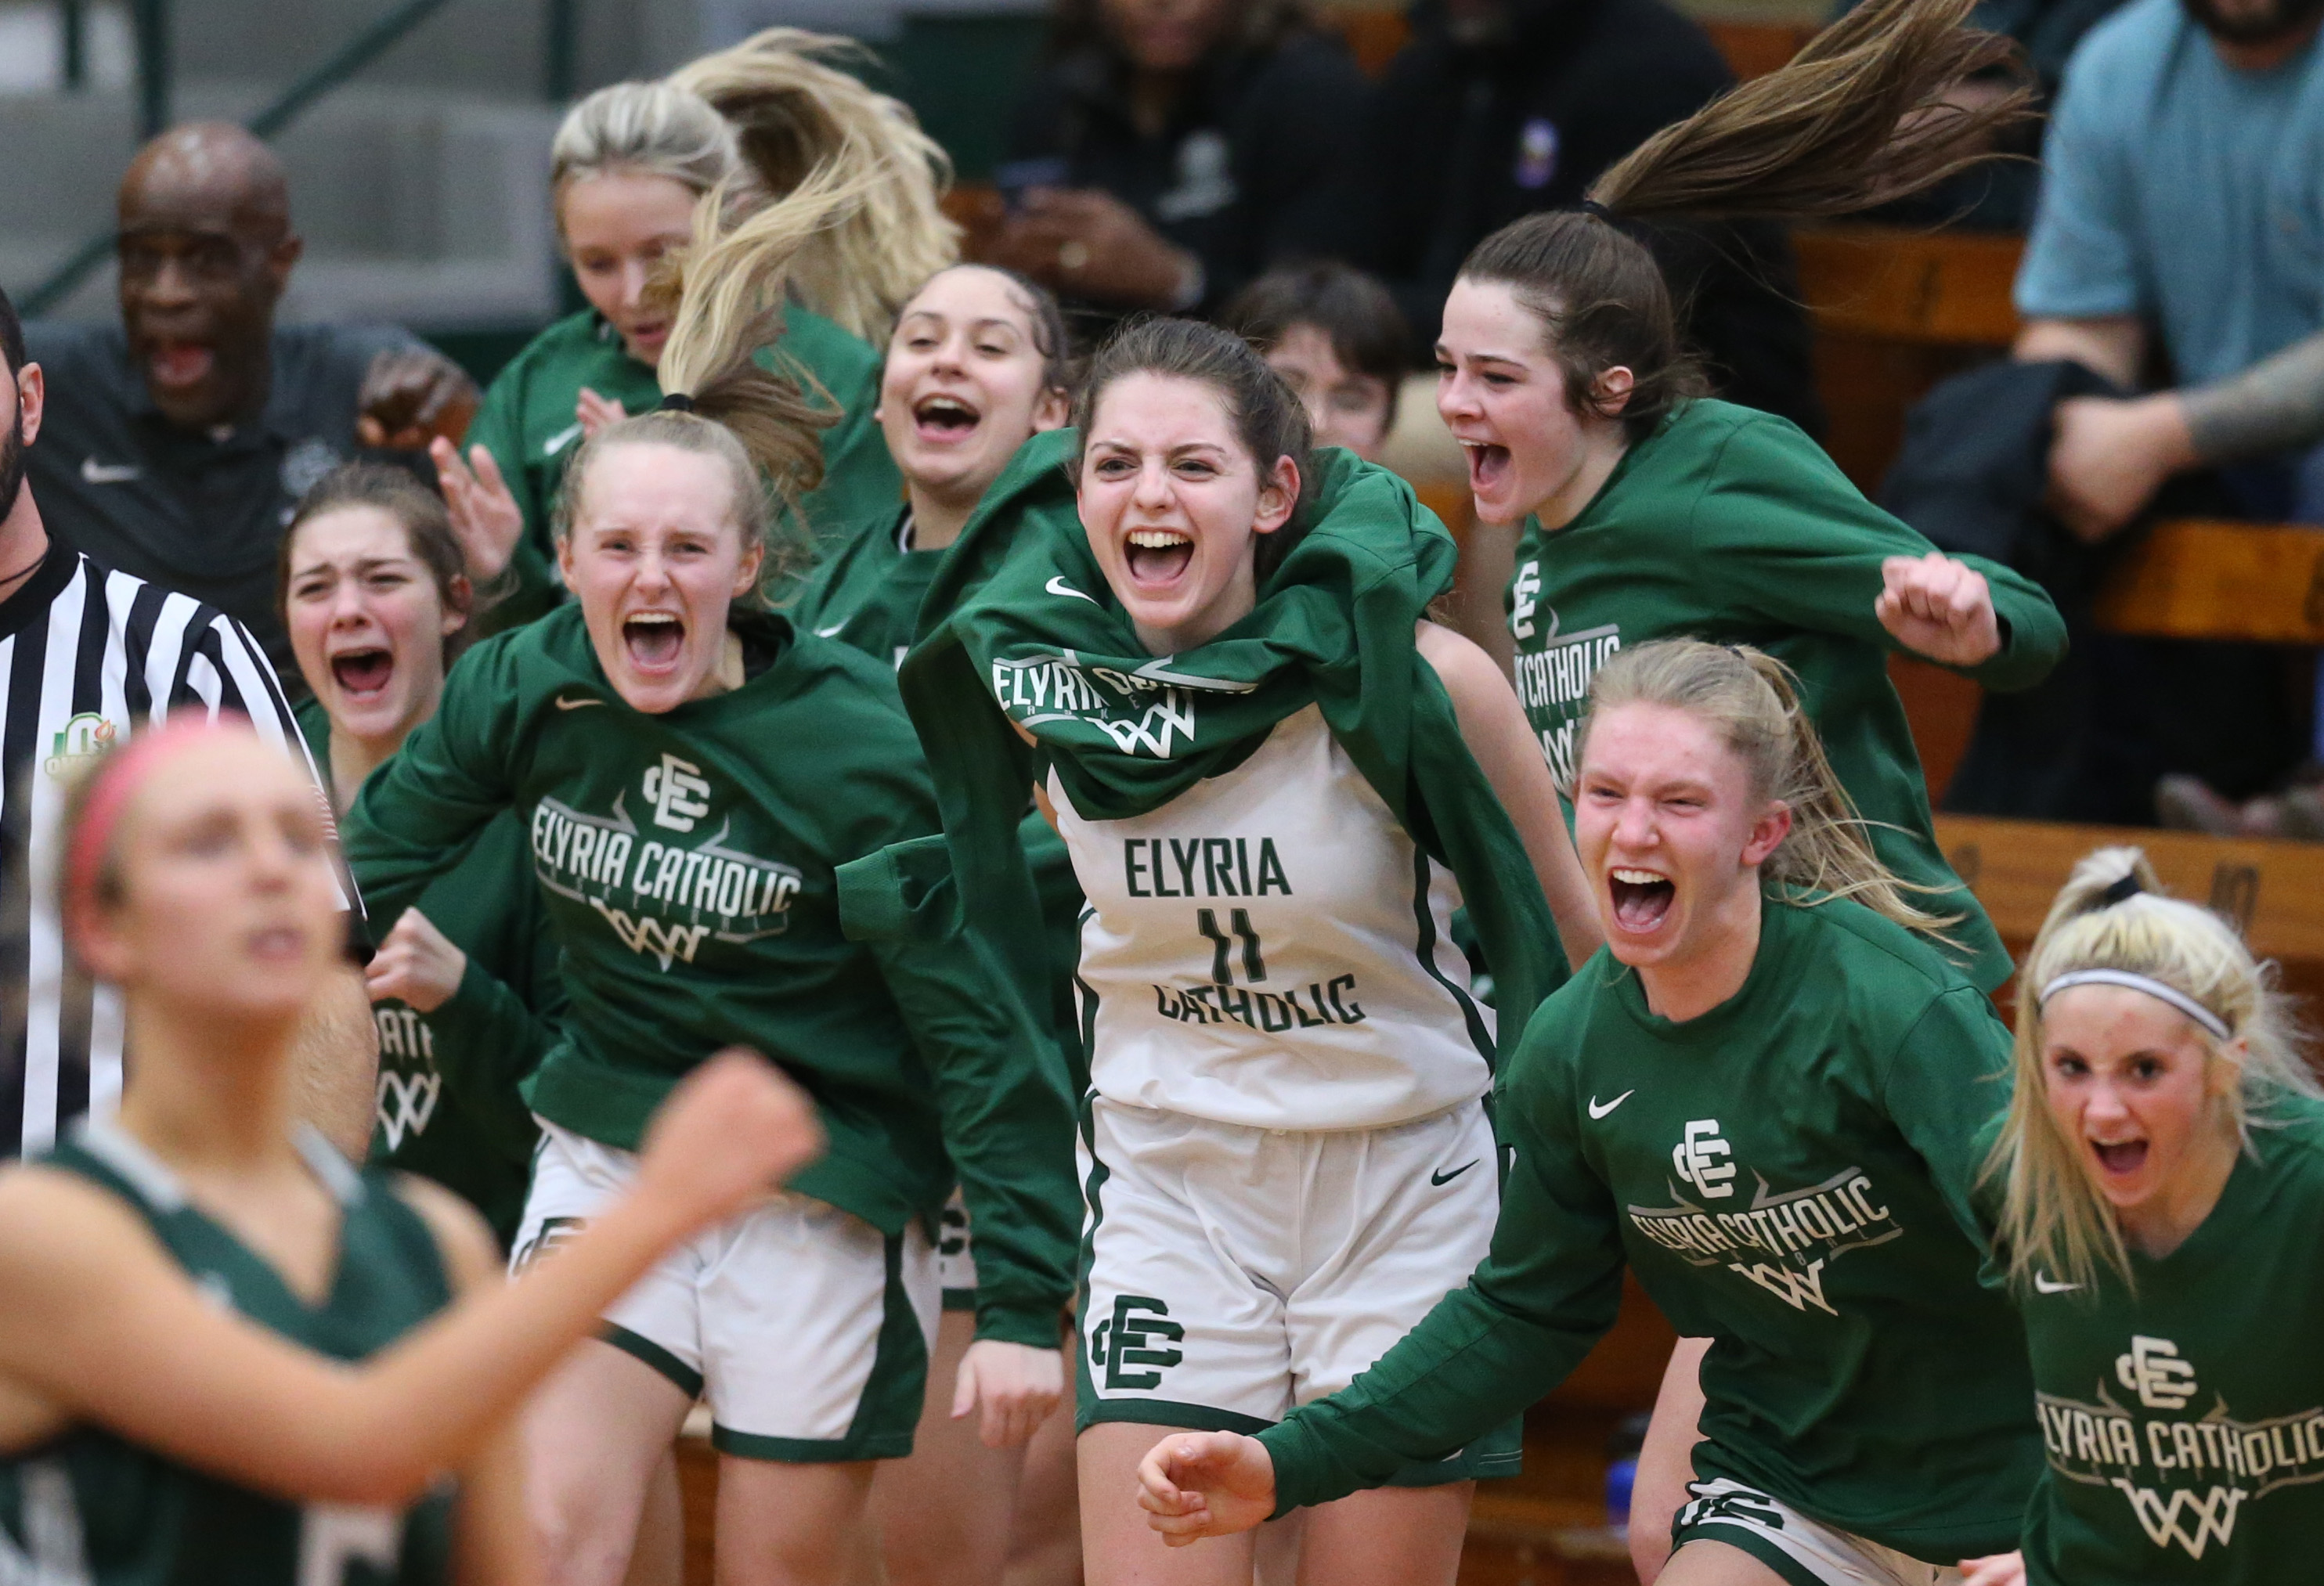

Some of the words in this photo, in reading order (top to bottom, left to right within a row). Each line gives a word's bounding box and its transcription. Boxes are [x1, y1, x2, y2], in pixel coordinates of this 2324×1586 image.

[532, 803, 633, 888] ELYRIA
[633, 841, 801, 918] CATHOLIC
[1124, 837, 1293, 897] ELYRIA
[1196, 907, 1267, 986] 11
[1153, 973, 1366, 1033] CATHOLIC
[1716, 1176, 1889, 1257] CATHOLIC
